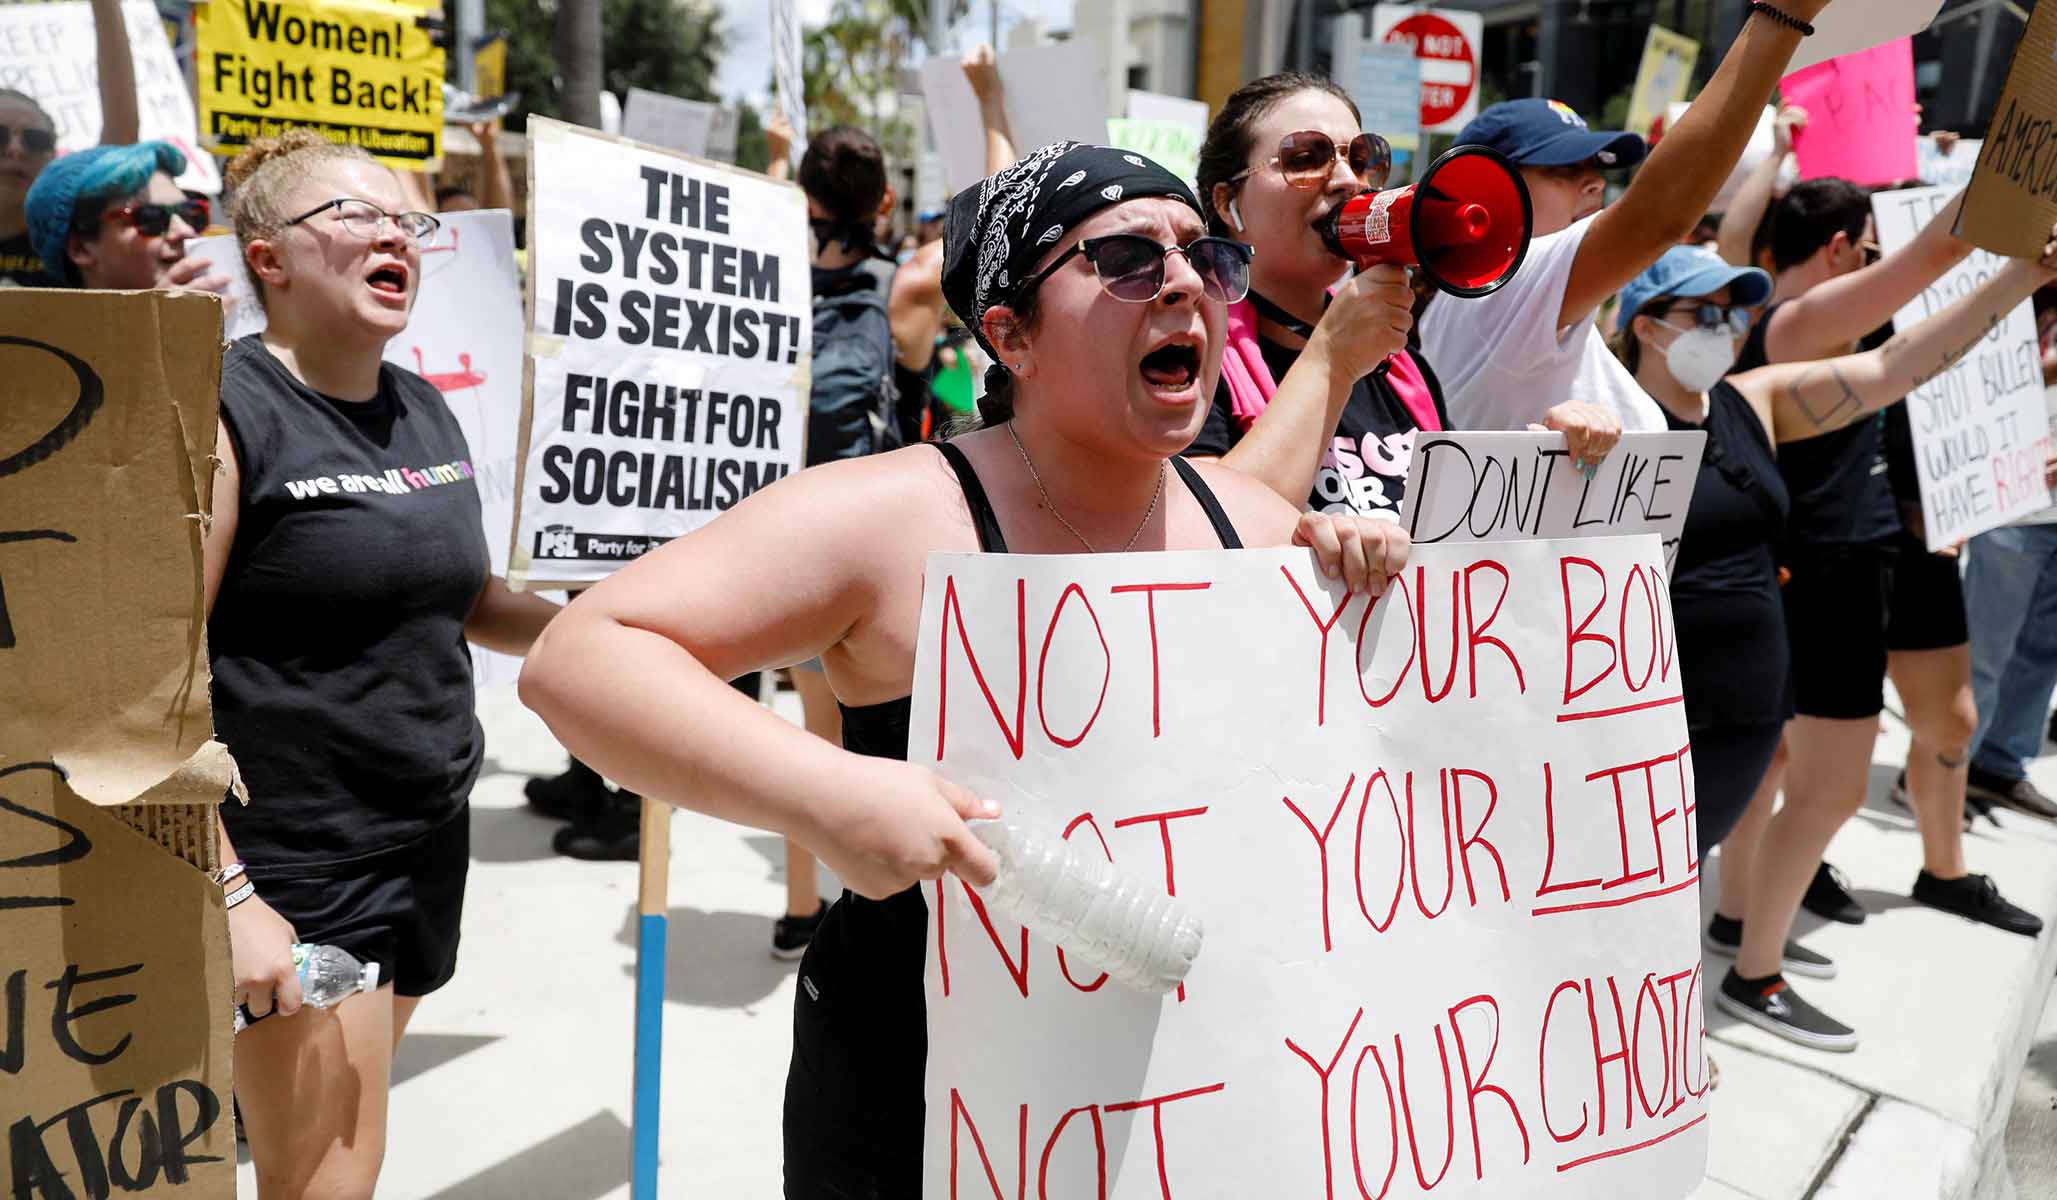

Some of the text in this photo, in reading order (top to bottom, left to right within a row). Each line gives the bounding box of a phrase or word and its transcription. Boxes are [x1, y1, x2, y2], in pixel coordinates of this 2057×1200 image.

[245, 0, 401, 58] Women!
[1424, 36, 1463, 55] NOT
[214, 52, 314, 108] Fight
[331, 67, 430, 114] Back!
[219, 114, 258, 139] Party
[362, 128, 429, 154] Liberation
[640, 165, 730, 235] THE
[580, 218, 780, 303] SYSTEM
[554, 278, 800, 364] IS SEXIST!
[562, 373, 781, 449] FIGHT FOR
[1996, 410, 2018, 450] IT
[285, 475, 338, 499] we
[337, 474, 384, 493] are
[379, 468, 411, 494] all
[401, 460, 475, 490] human
[1315, 468, 1393, 511] OUR
[1573, 452, 1684, 528] LIKE
[1931, 473, 1992, 536] HAVE
[539, 529, 579, 558] PSL
[587, 538, 624, 559] Party
[625, 541, 652, 556] for
[937, 575, 1212, 761] NOT
[1281, 556, 1526, 727] YOUR
[1283, 765, 1511, 952] YOUR
[950, 1084, 1225, 1200] NOT
[1285, 994, 1530, 1200] YOUR
